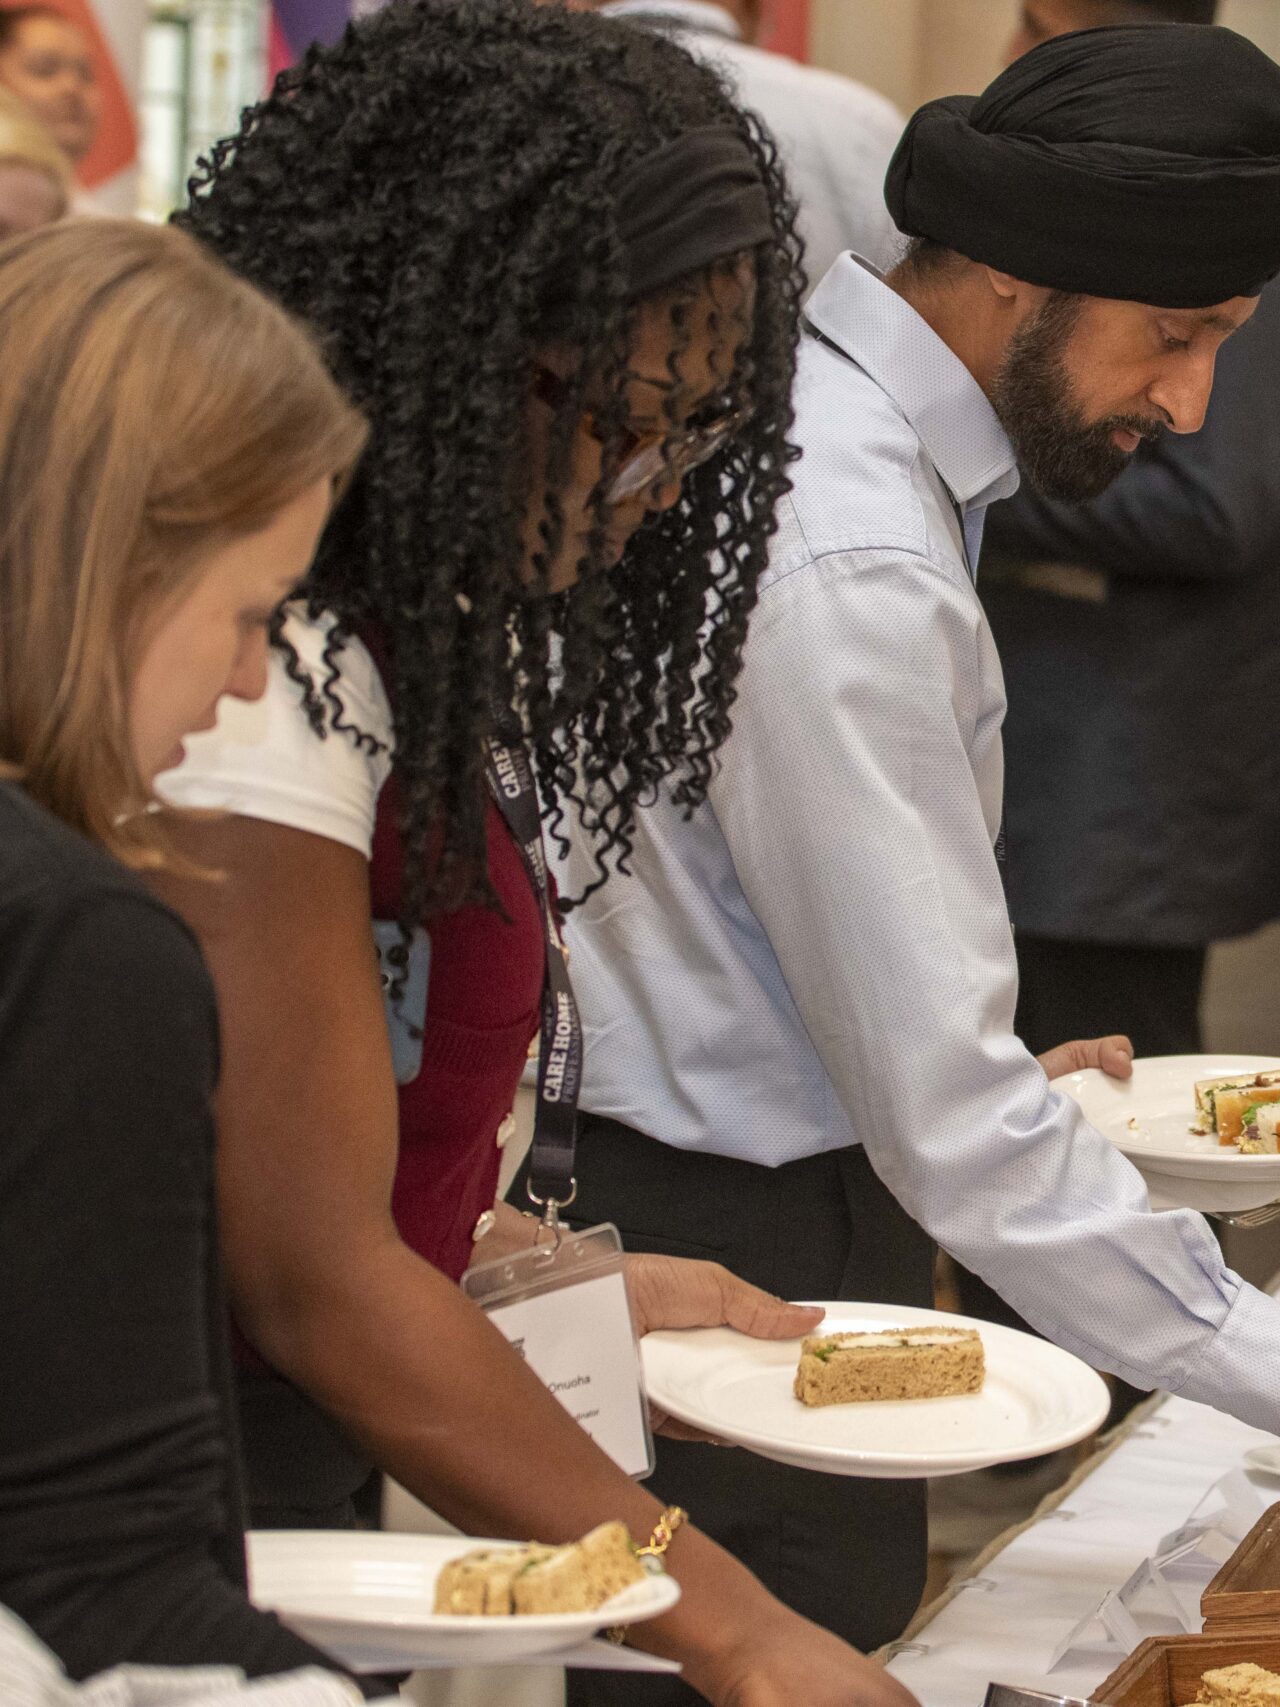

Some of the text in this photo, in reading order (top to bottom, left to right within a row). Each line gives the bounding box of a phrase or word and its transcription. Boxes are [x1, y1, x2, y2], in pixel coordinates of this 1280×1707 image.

[491, 747, 521, 799] CARE
[542, 991, 571, 1102] CARE HOME
[548, 1376, 591, 1393] Onuoha
